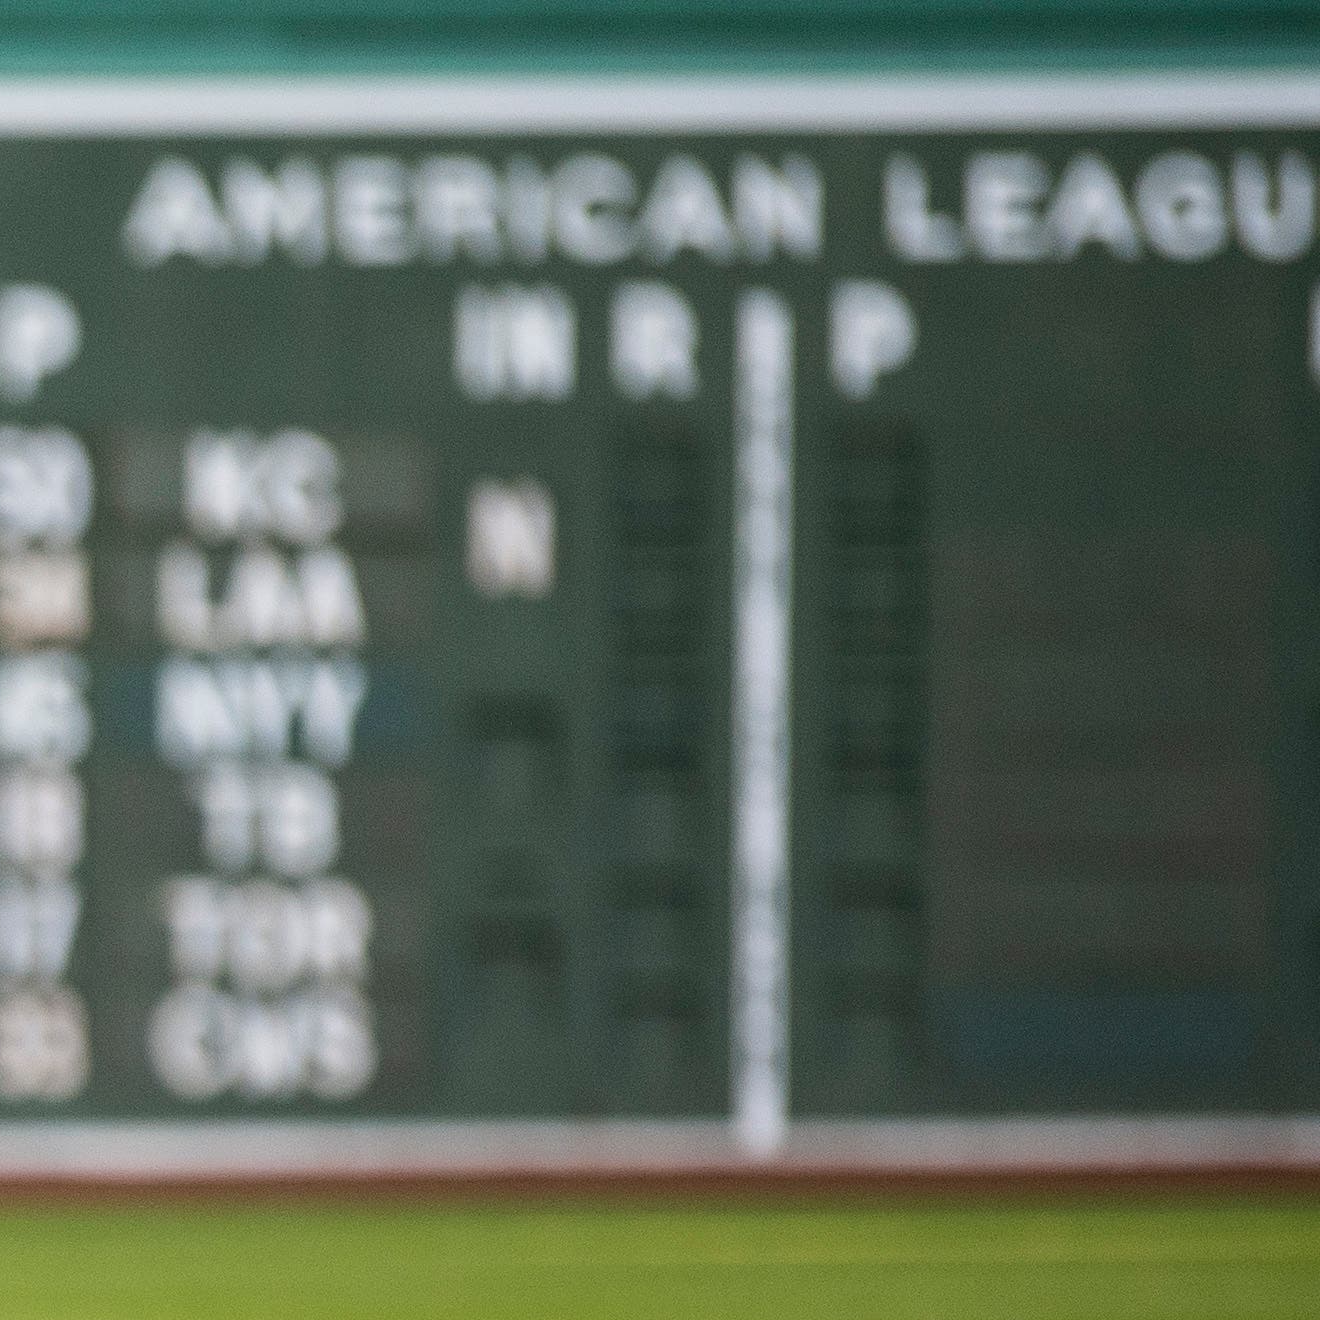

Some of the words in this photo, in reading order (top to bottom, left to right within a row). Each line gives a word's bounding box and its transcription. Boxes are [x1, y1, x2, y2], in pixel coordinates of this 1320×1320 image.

[125, 157, 821, 264] AMERICAN
[884, 153, 1317, 261] LEAGU
[612, 284, 696, 393] R
[830, 282, 914, 394] P
[184, 433, 338, 541] KC
[159, 541, 362, 652] LAA
[168, 875, 368, 988] TOR
